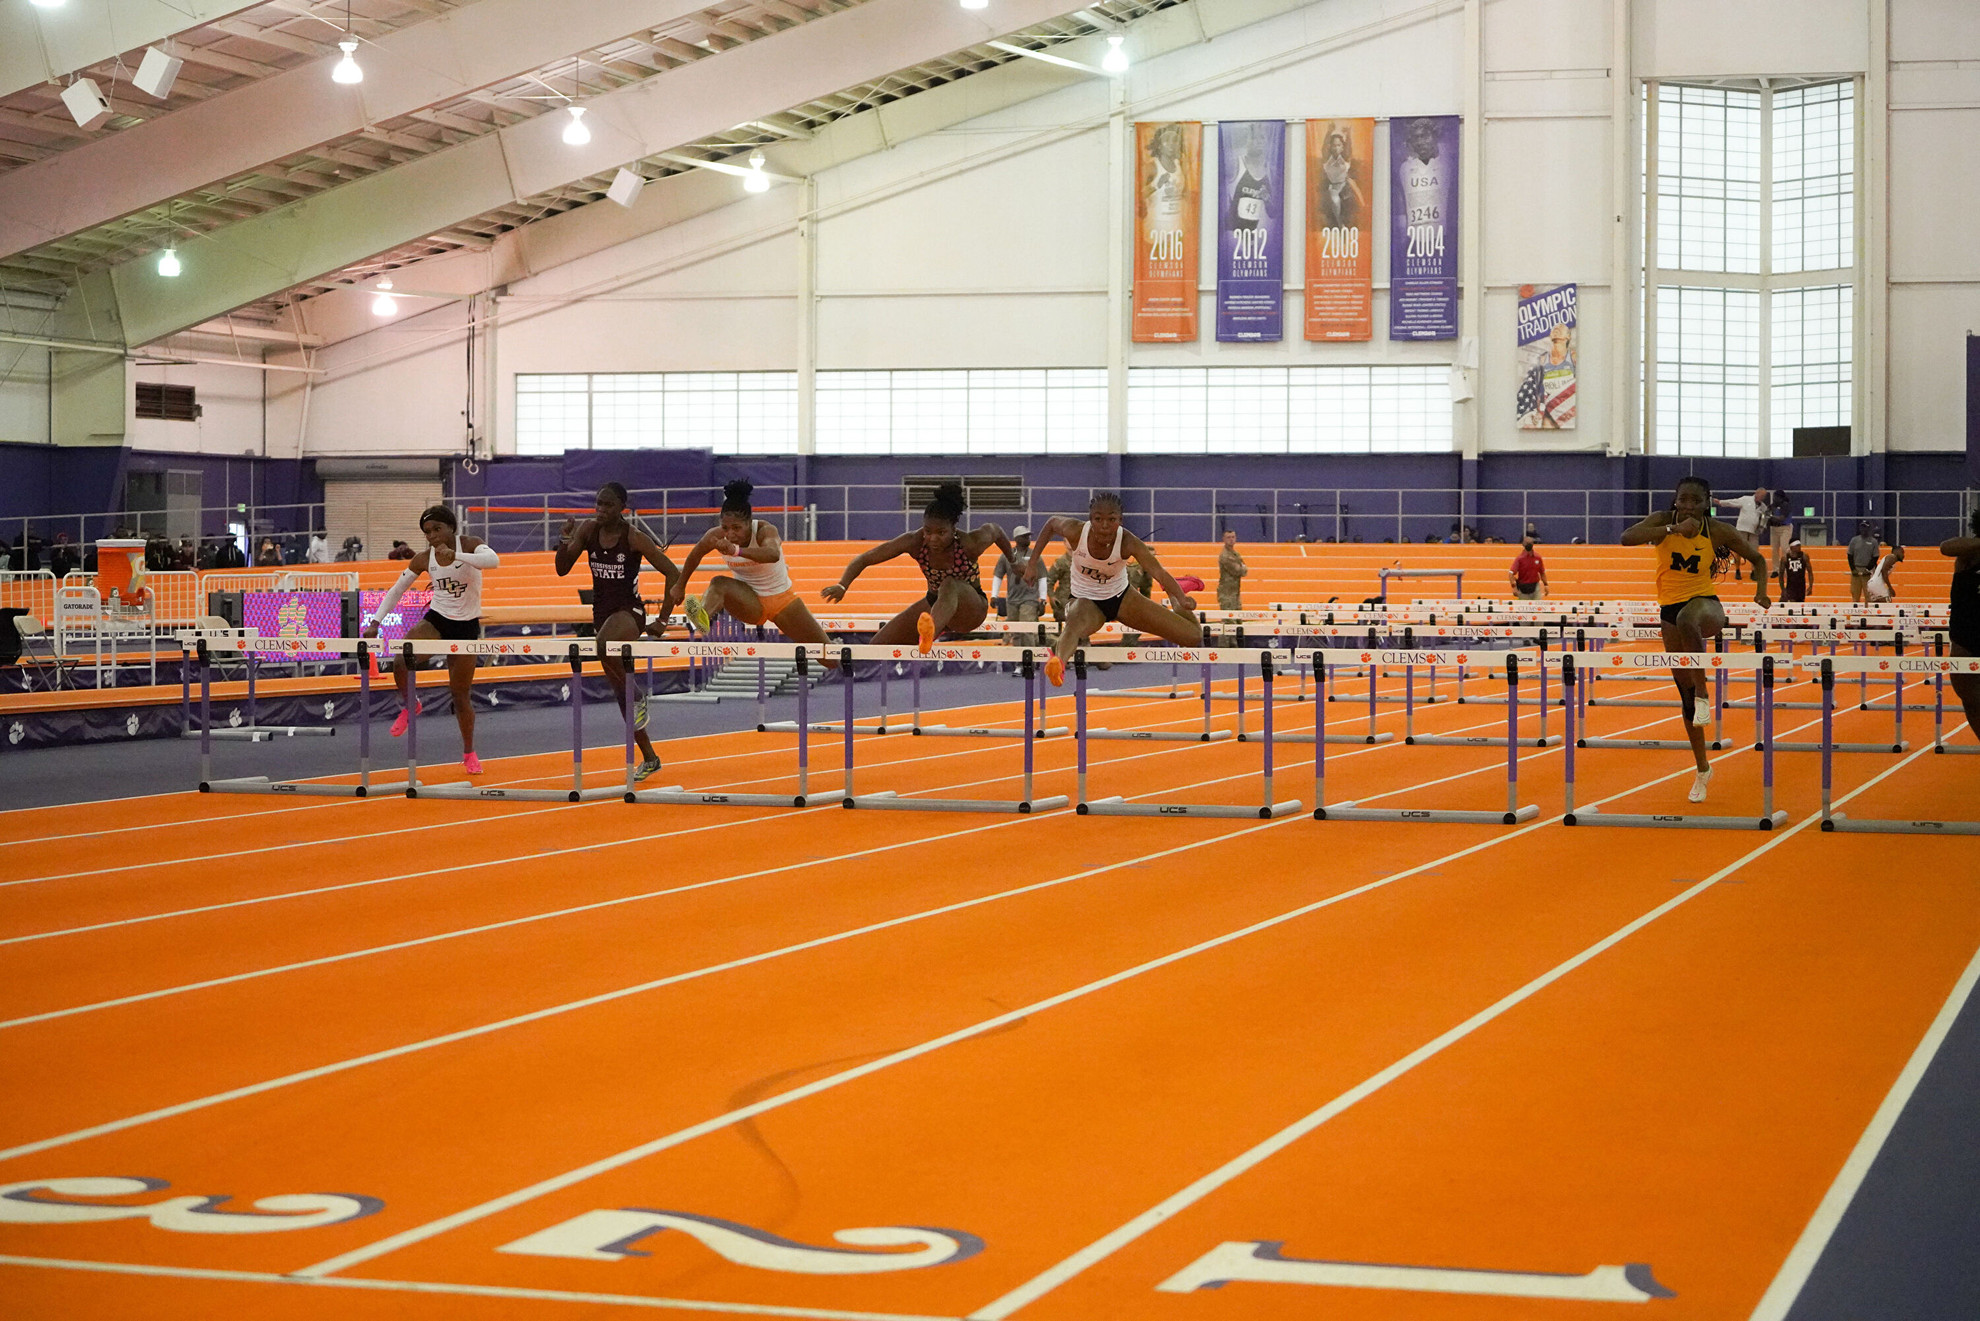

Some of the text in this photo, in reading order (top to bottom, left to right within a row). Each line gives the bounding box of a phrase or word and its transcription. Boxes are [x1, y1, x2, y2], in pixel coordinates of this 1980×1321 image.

[1411, 176, 1439, 187] USA
[1245, 203, 1257, 215] 43
[1411, 206, 1439, 222] 3246
[1150, 229, 1183, 260] 2016
[1233, 228, 1267, 259] 2012
[1322, 226, 1358, 258] 2008
[1407, 225, 1445, 257] 2004
[1150, 261, 1183, 269] CLEMSON
[1233, 261, 1267, 269] CLEMSON
[1321, 259, 1356, 267] CLEMSON
[1407, 258, 1442, 266] CLEMSON
[1149, 269, 1183, 277] OLYMPIANS
[1233, 269, 1267, 277] OLYMPIANS
[1321, 267, 1356, 276] OLYMPIANS
[1406, 266, 1442, 275] OLYMPIANS
[1519, 287, 1576, 323] OLYMPIC
[1518, 305, 1576, 340] TRADITION
[590, 561, 624, 570] MISSISSIPPI
[1670, 552, 1701, 574] M
[592, 568, 625, 579] STATE
[436, 577, 468, 598] UCF
[1452, 628, 1498, 636] CLEMSON
[1805, 631, 1851, 640] CLEMSON
[255, 640, 308, 650] CLEMSON
[466, 643, 514, 653] CLEMSON
[687, 645, 739, 656] CLEMSON
[1145, 650, 1200, 661] CLEMSON
[1382, 652, 1446, 664] CLEMSON
[1634, 655, 1700, 667] CLEMSON
[1899, 661, 1959, 671] CLEMSON
[1159, 806, 1187, 814] UCS
[1401, 810, 1430, 818] UCS
[0, 1177, 385, 1233] 3
[494, 1207, 985, 1274] 2
[1154, 1240, 1678, 1303] 1
